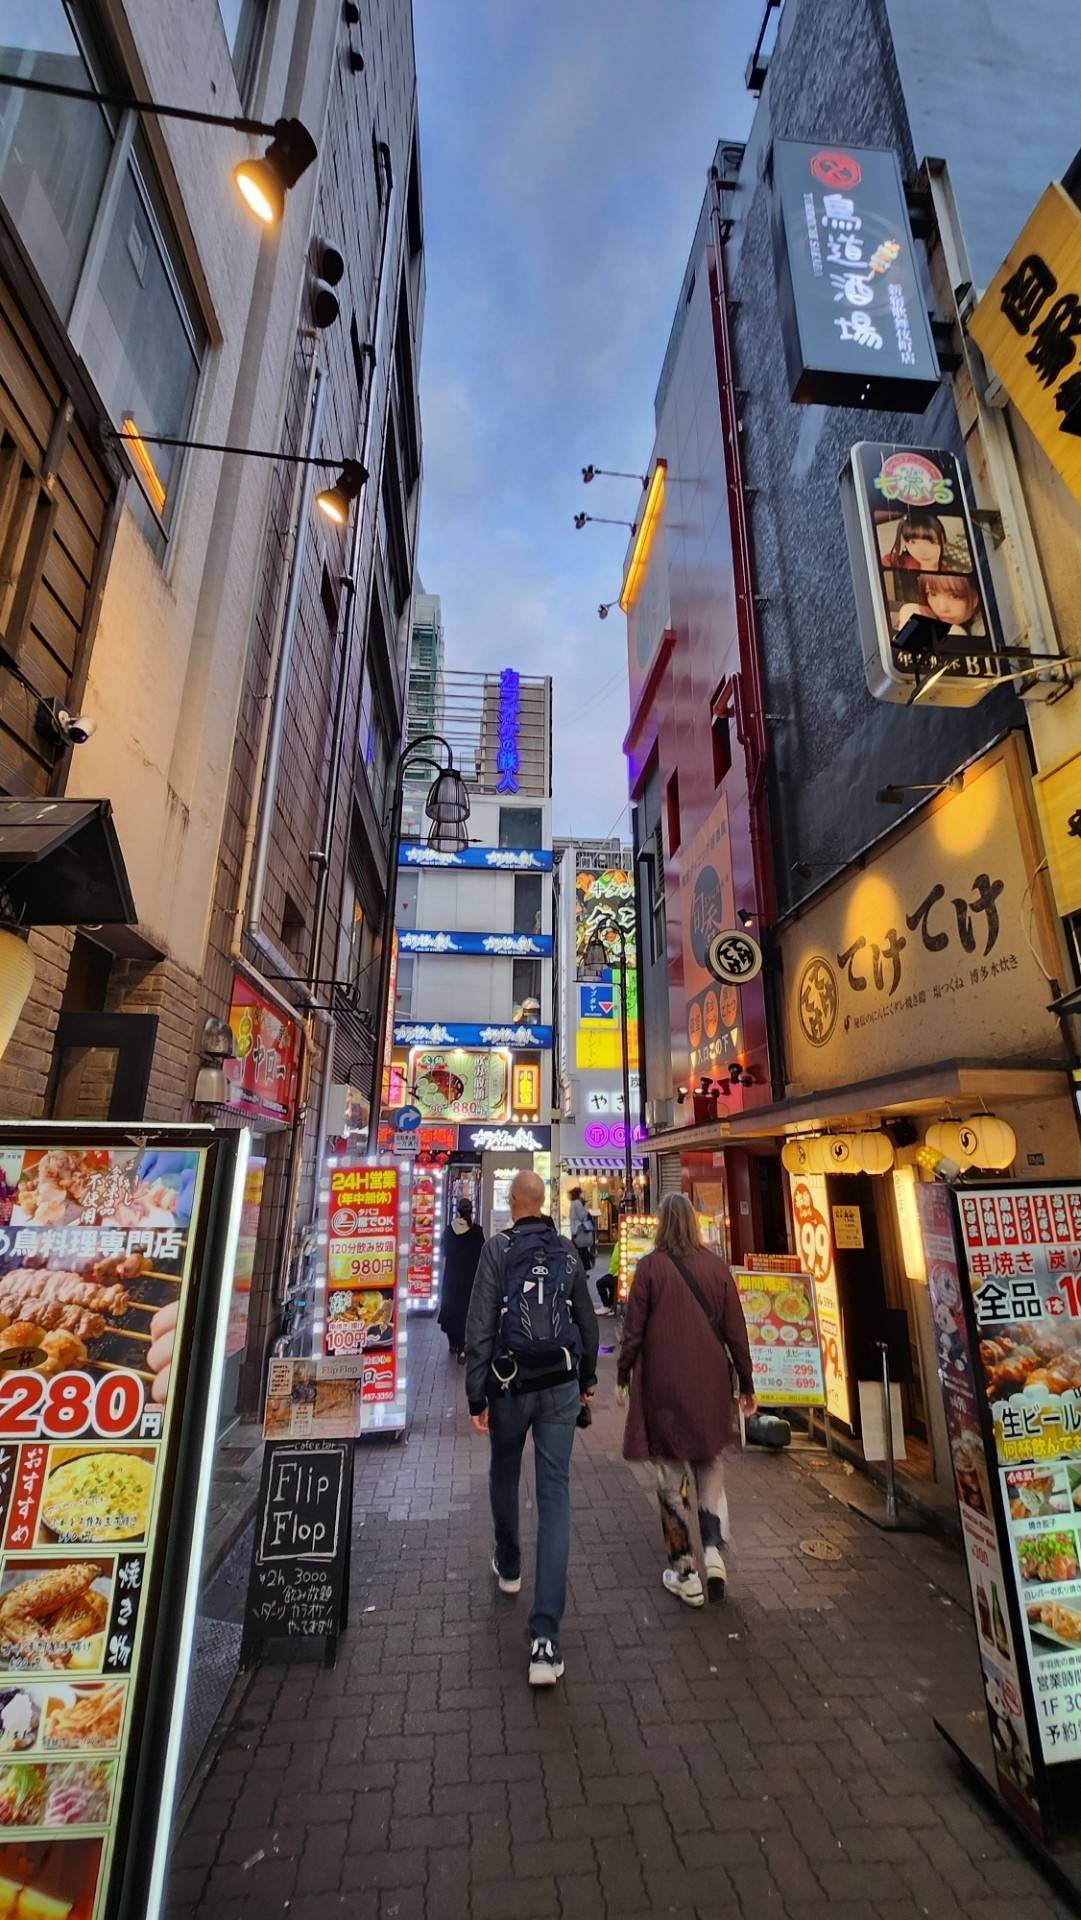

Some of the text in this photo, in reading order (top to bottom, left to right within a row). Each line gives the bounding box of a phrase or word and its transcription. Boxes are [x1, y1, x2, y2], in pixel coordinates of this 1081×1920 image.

[837, 873, 1004, 996] てけてけ
[332, 1170, 397, 1191] 24H営業
[337, 1191, 392, 1206] (年中無休)
[351, 1258, 393, 1275] 980円
[971, 1250, 1034, 1277] 串焼き
[976, 1283, 1043, 1320] 全品
[1002, 1403, 1081, 1438] 生ビール
[11, 1447, 44, 1544] おすすめ
[273, 1462, 329, 1504] Flip
[270, 1510, 326, 1552] Flop
[267, 1567, 327, 1587] 2h 3000
[292, 1603, 326, 1619] カラオケ
[1041, 1697, 1059, 1717] 1F
[1045, 1719, 1081, 1746] 予約
